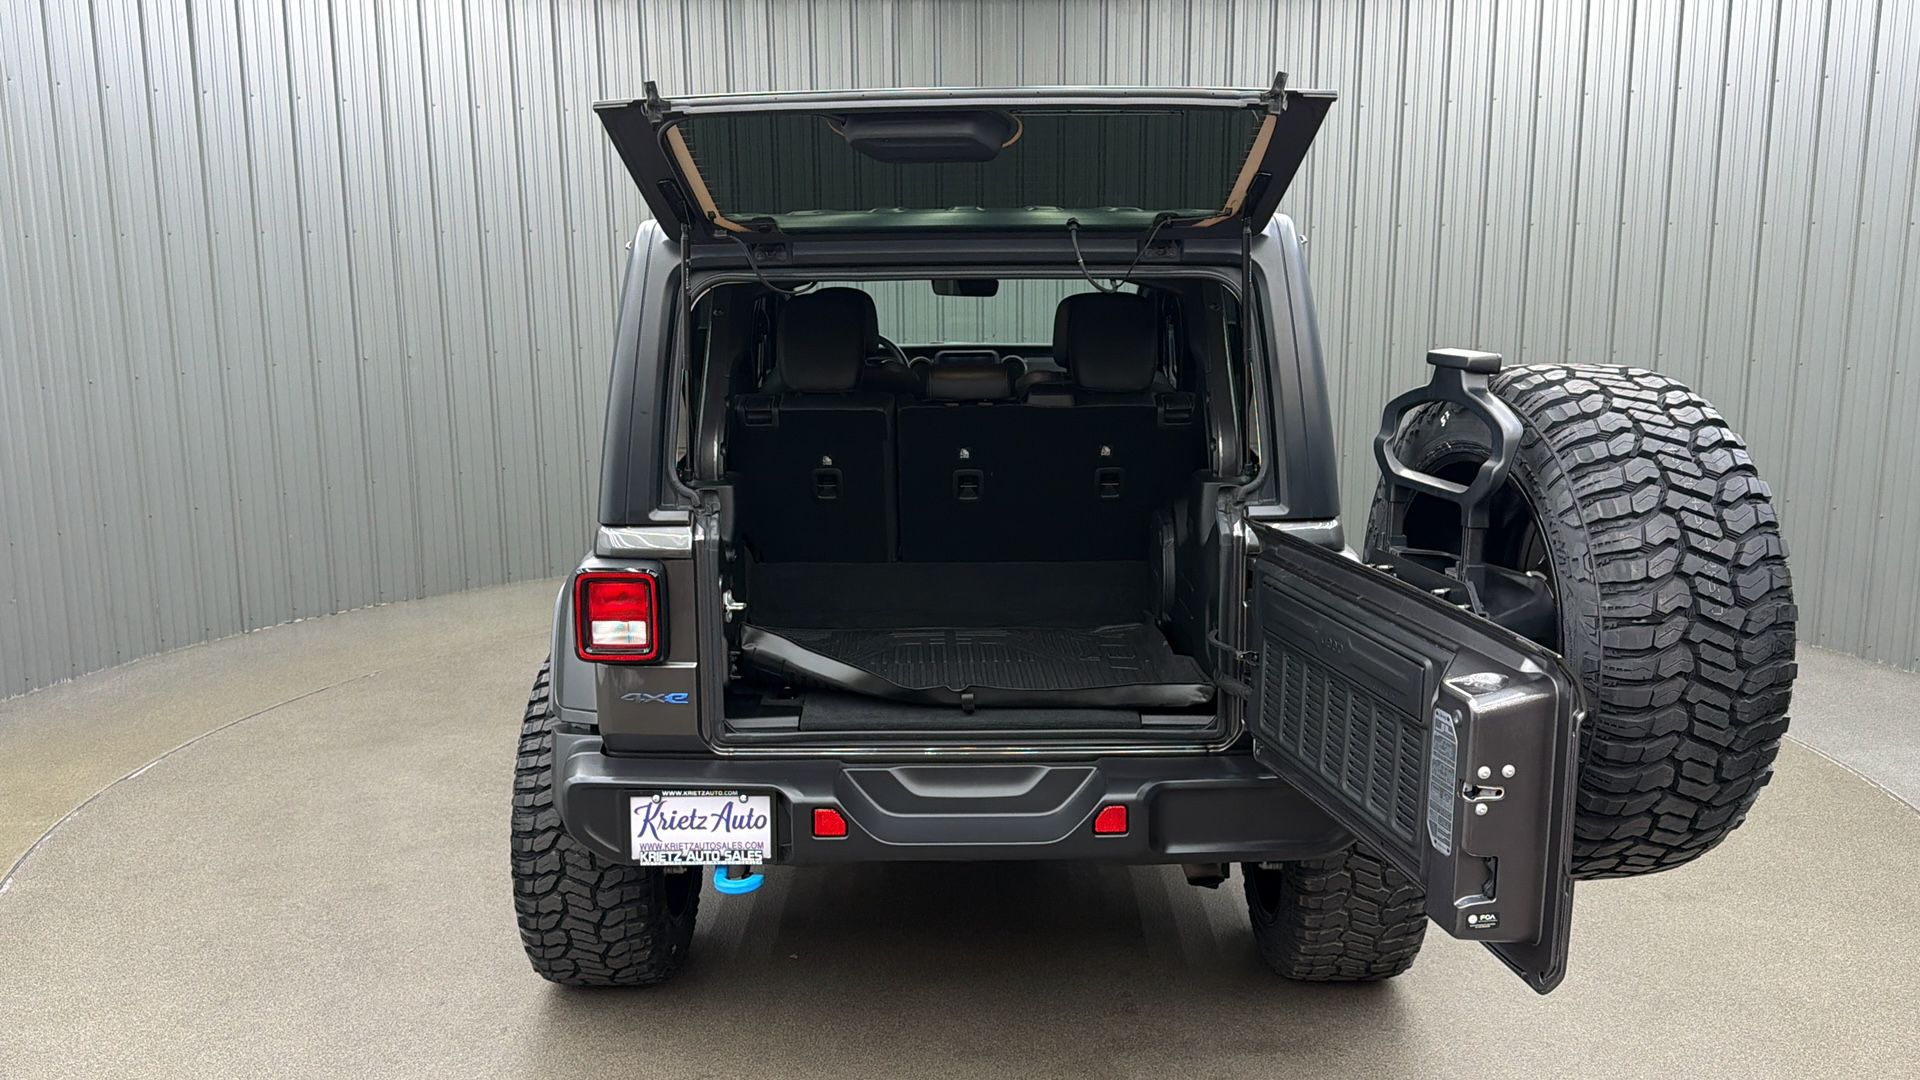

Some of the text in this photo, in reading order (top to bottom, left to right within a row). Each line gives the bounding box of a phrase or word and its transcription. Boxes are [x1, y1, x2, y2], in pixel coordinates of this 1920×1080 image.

[633, 800, 768, 842] Krietz Auto
[639, 841, 765, 851] WWW.KRIETZAUTOSALES.COM
[640, 850, 763, 862] KRIETZ AUTO SALES
